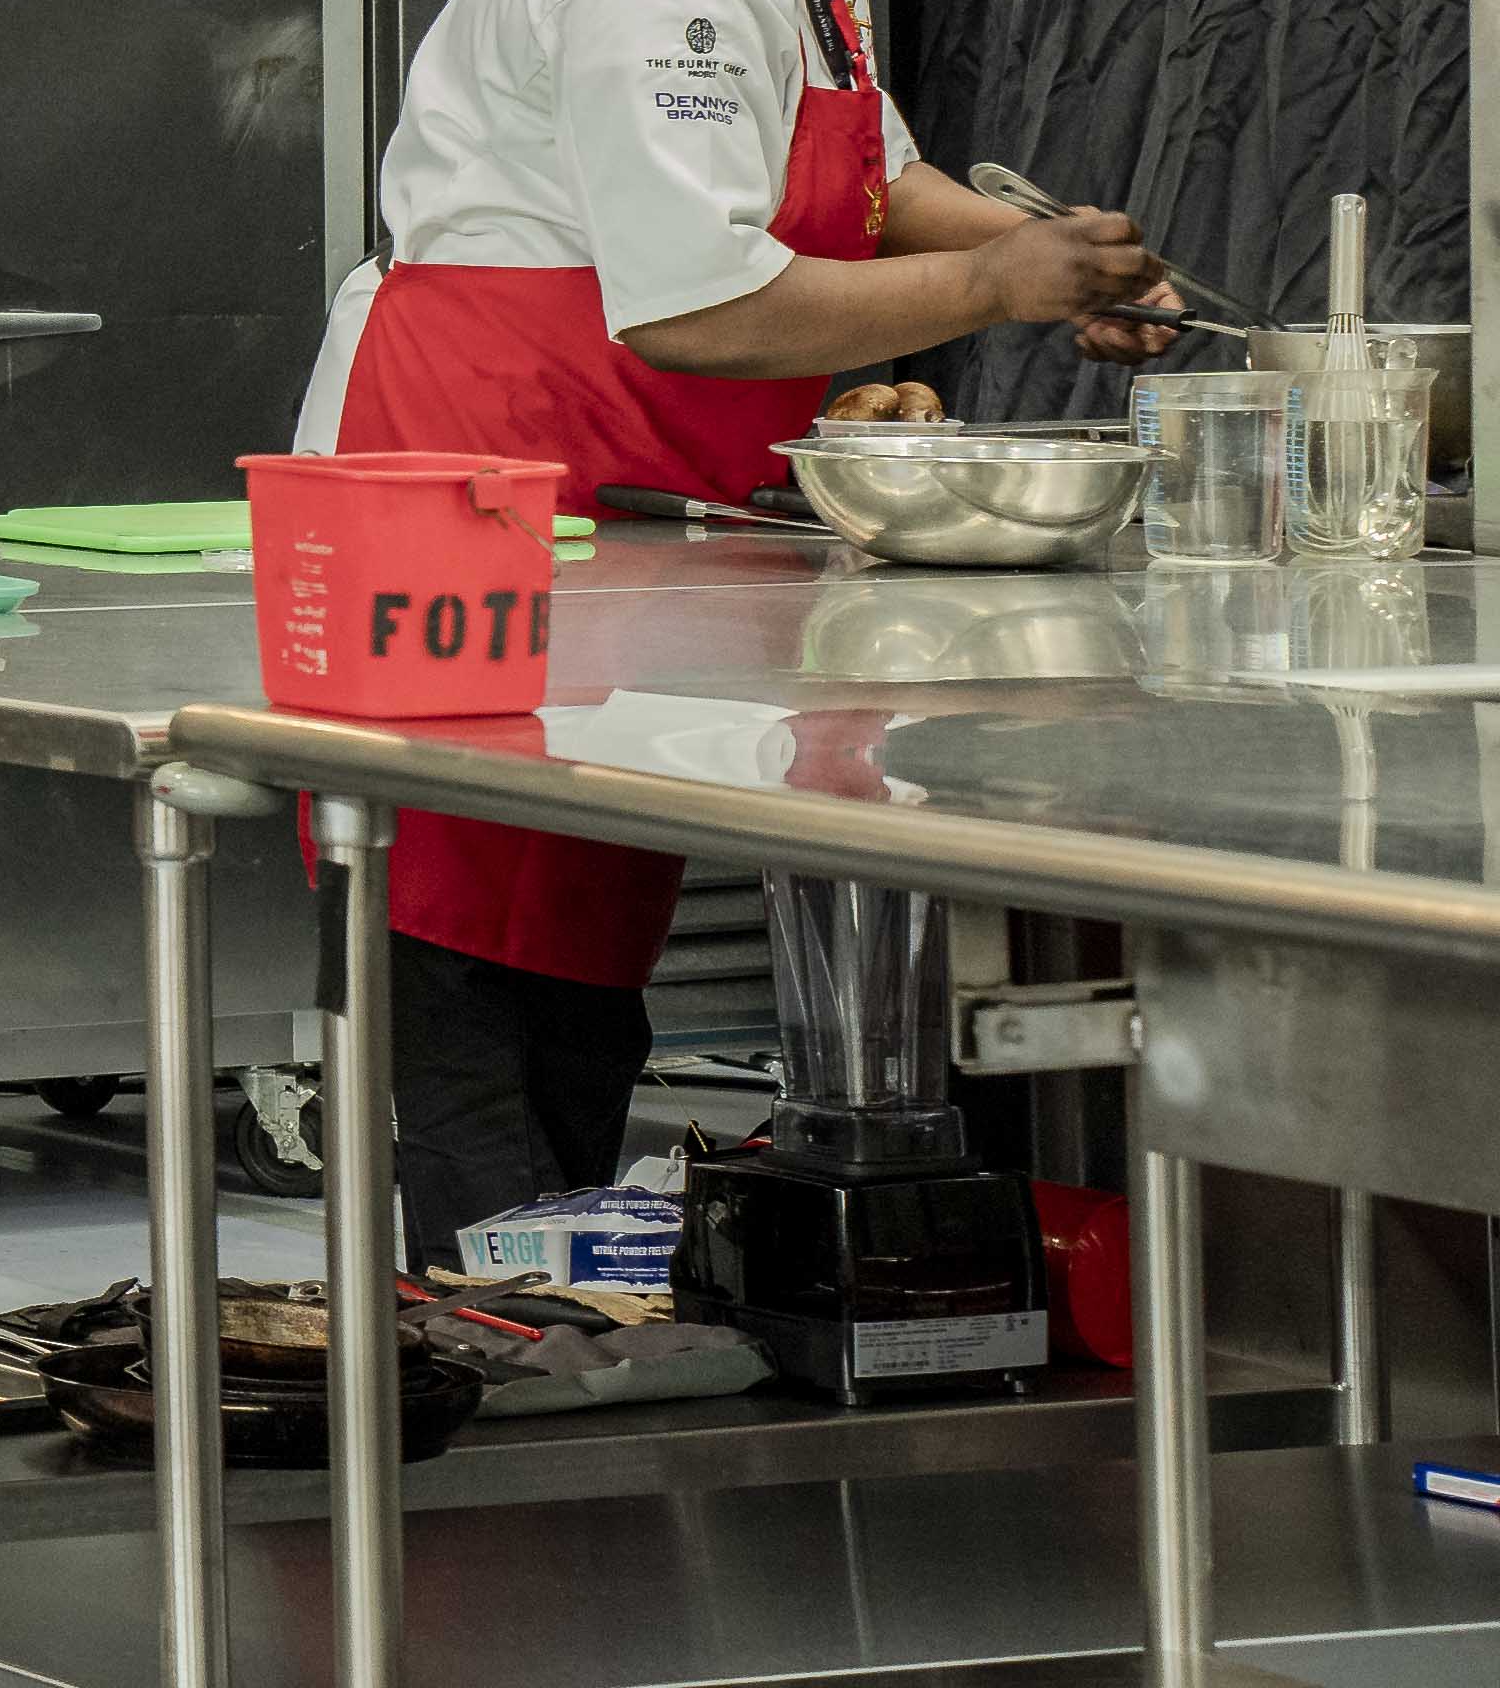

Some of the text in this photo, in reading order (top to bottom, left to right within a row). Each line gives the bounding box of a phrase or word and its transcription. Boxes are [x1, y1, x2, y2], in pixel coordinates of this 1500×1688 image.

[645, 59, 748, 77] THE BURNT CHEF
[655, 92, 740, 115] DENNYS
[666, 109, 733, 126] BRANDS
[468, 1230, 548, 1266] VERGE
